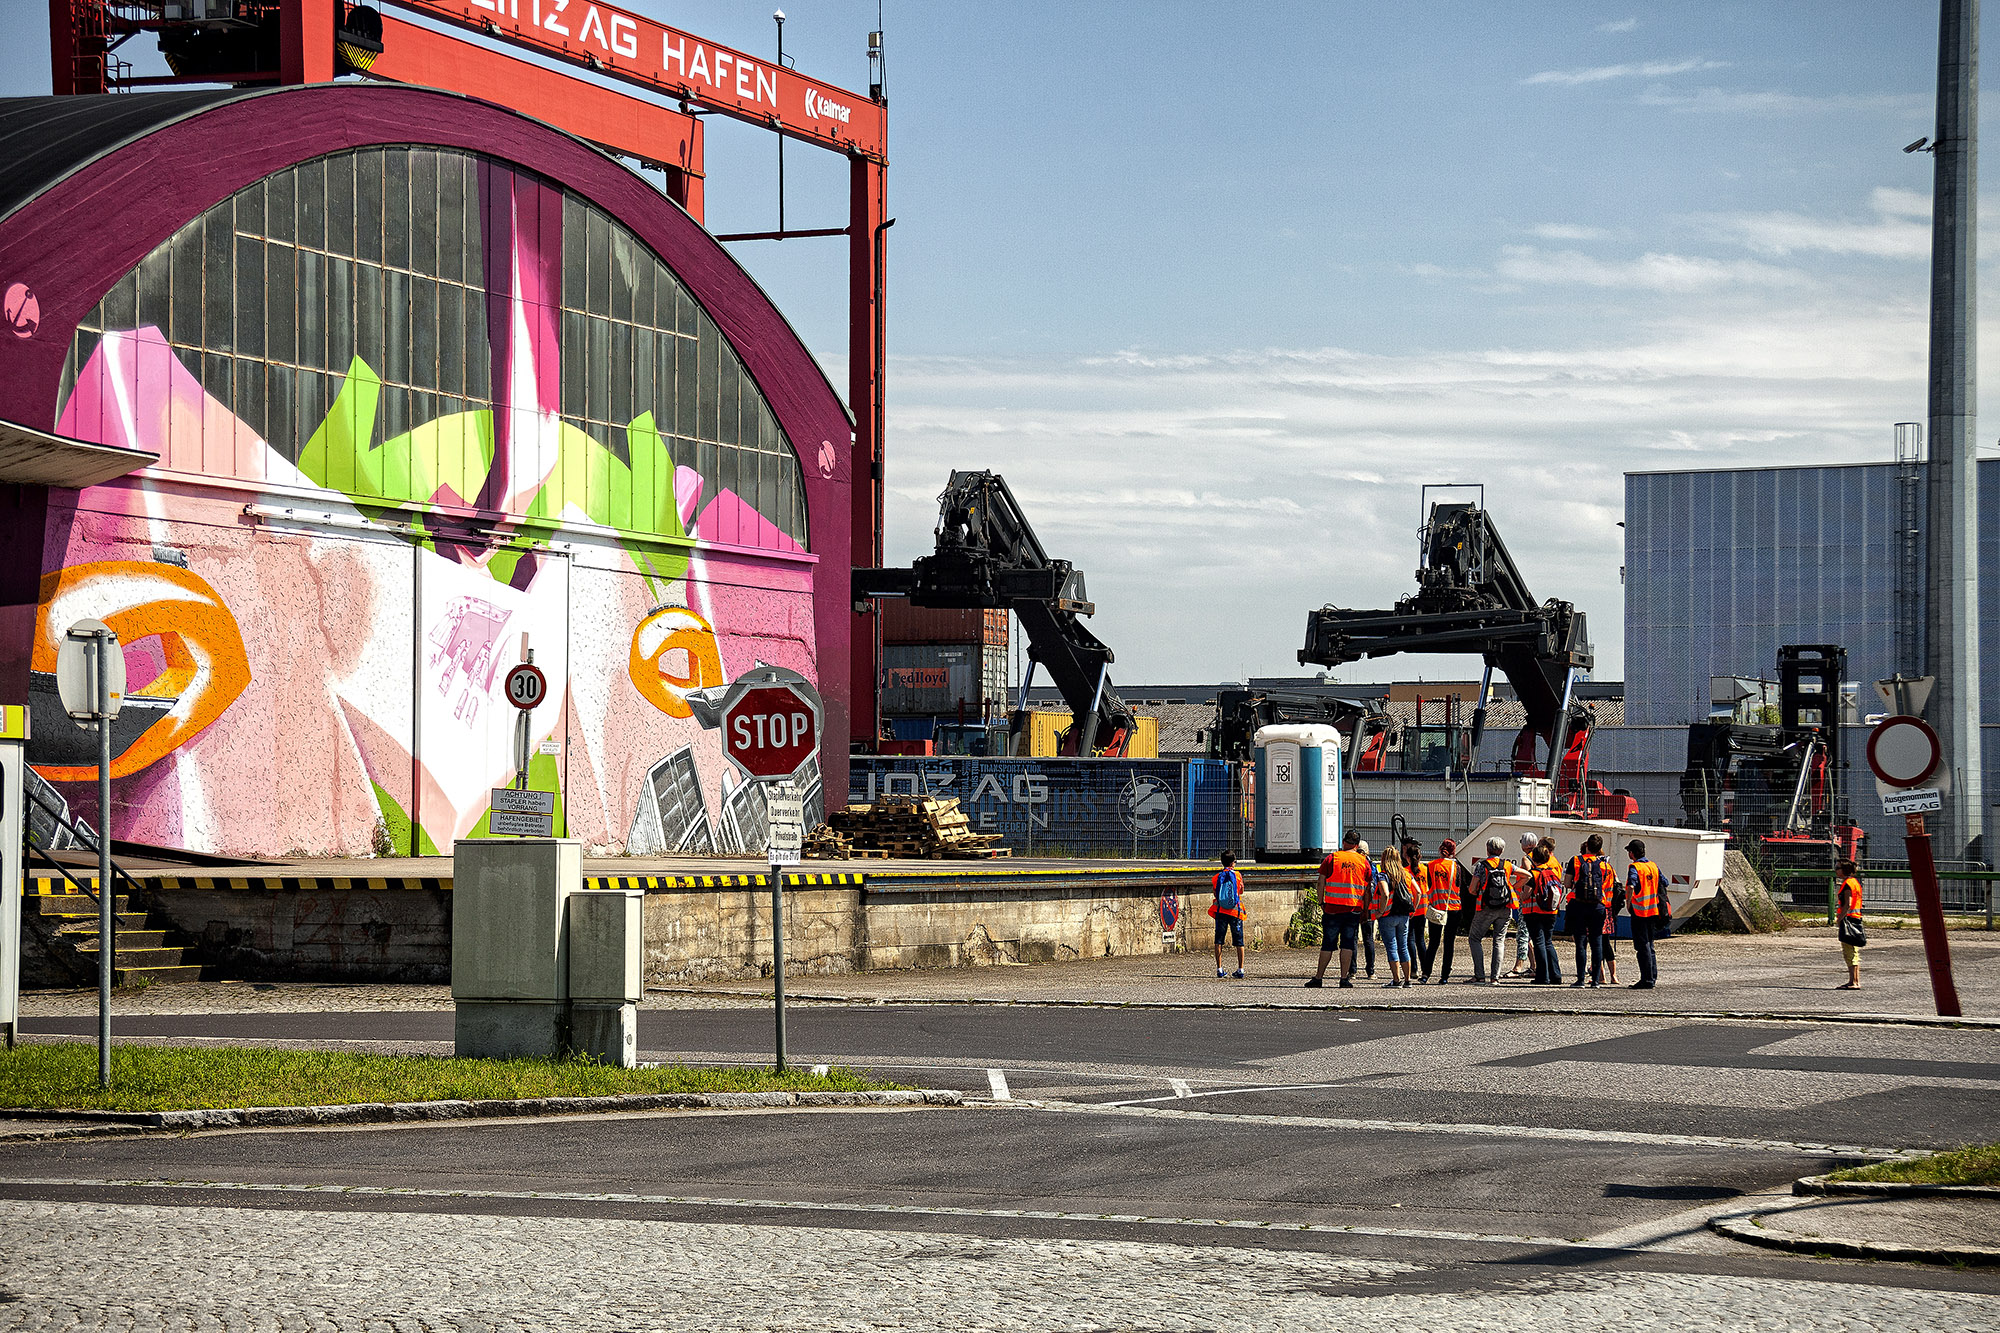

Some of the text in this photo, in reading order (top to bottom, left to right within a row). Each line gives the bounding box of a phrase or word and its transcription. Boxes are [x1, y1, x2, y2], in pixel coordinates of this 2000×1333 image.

[470, 0, 777, 108] NZ AG HAFEN
[817, 95, 851, 124] Kalmar
[514, 674, 537, 699] 30
[892, 670, 947, 686] edlloyd
[734, 712, 808, 750] STOP
[1276, 773, 1291, 782] TOI
[970, 774, 1049, 803] AG
[1884, 791, 1938, 804] Ausgenommen
[1885, 801, 1940, 814] LINZ AG
[500, 815, 543, 823] HAFENGEBIET
